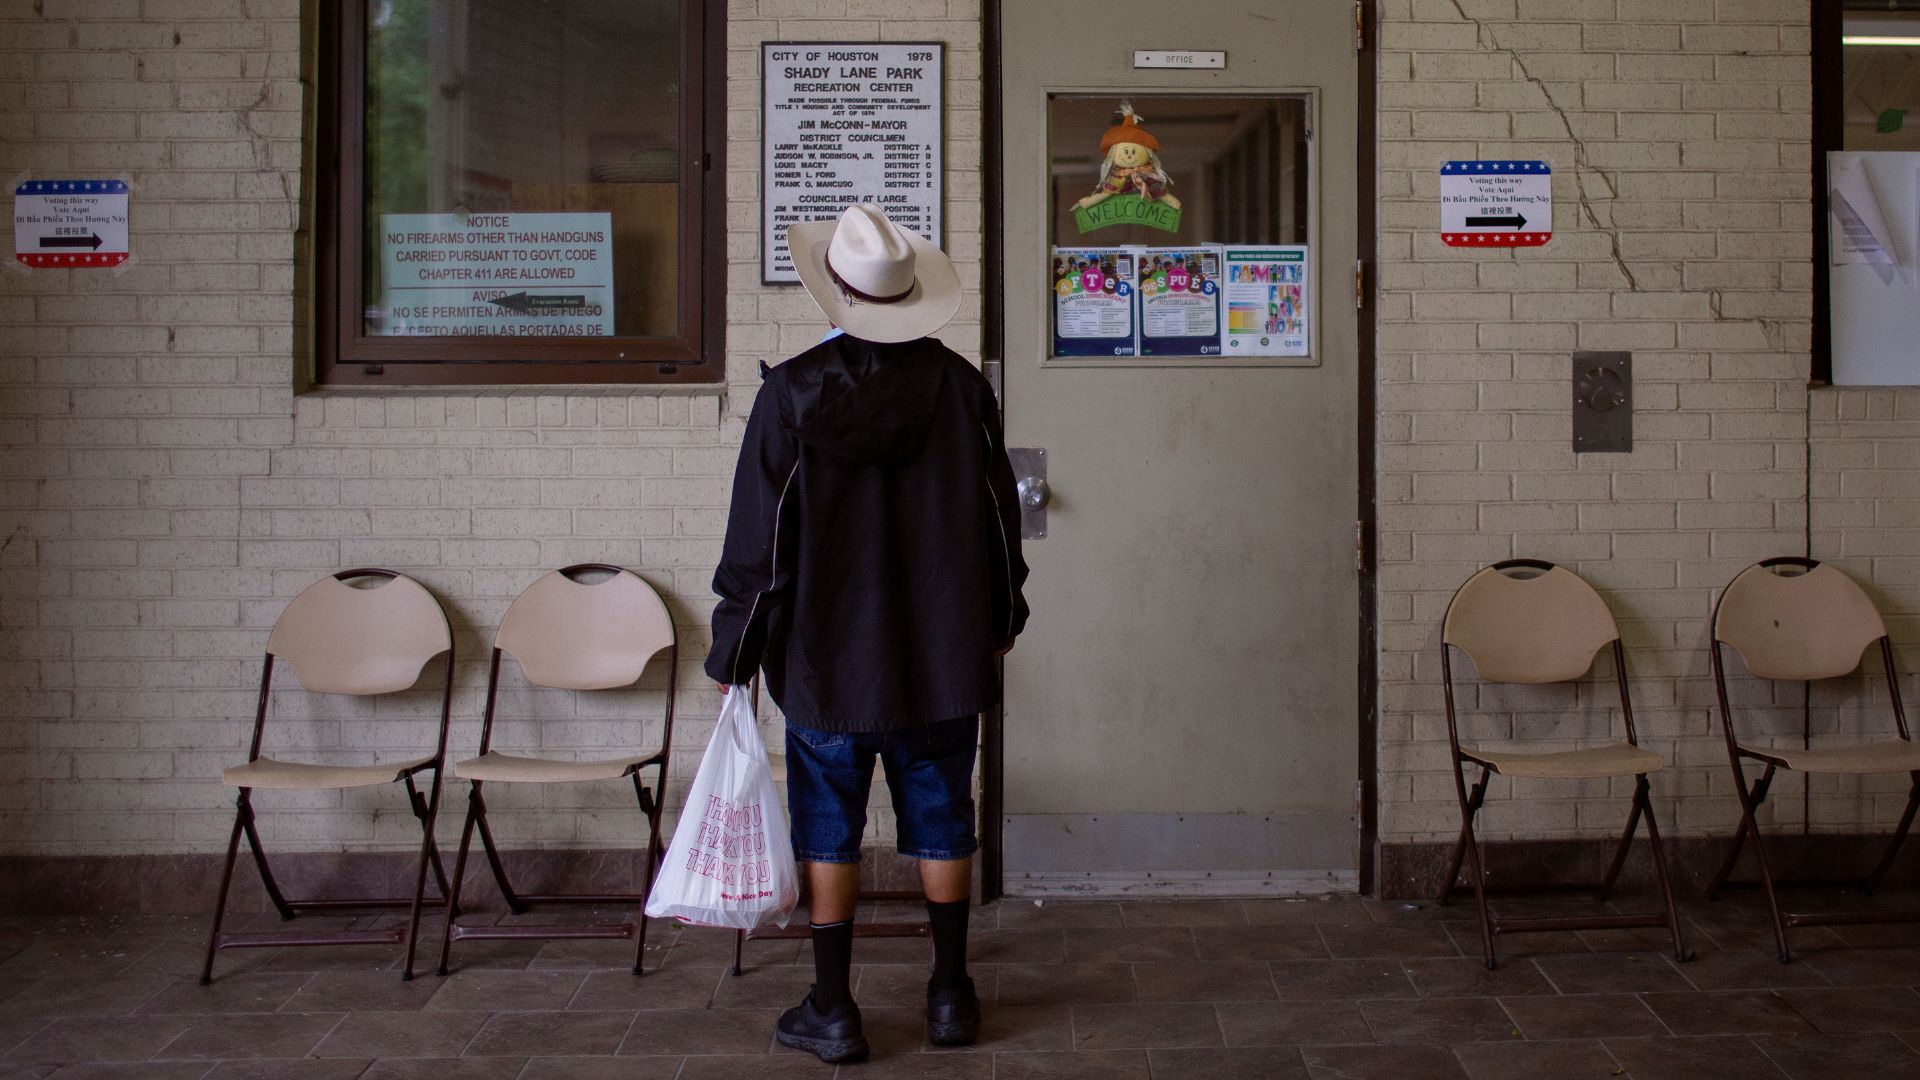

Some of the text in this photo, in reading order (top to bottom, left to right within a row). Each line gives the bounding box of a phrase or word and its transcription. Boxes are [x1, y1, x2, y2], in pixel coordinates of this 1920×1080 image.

[772, 52, 932, 61] CITY OF HOUSTON 1978
[784, 67, 922, 79] SHADY LANE PARK
[794, 83, 913, 92] RECREATION CENTER
[798, 121, 815, 130] JIM
[1087, 200, 1170, 225] WELCOME
[467, 216, 509, 227] NOTICE
[388, 232, 604, 244] NO FIREARMS OTHER THAN HANDGUNS
[396, 251, 446, 262] CARRIED
[450, 251, 509, 262] PURSUANT
[513, 250, 528, 261] TO
[566, 249, 596, 260] CODE
[419, 268, 575, 280] CHAPTER 411 ARE ALLOWED
[473, 291, 506, 301] AVISO
[393, 307, 410, 318] NO
[414, 307, 429, 317] SE
[432, 306, 492, 317] PERMITEN
[542, 306, 558, 316] DE
[562, 305, 602, 316] FUEGO
[520, 325, 583, 336] PORTADAS
[587, 324, 602, 335] DE
